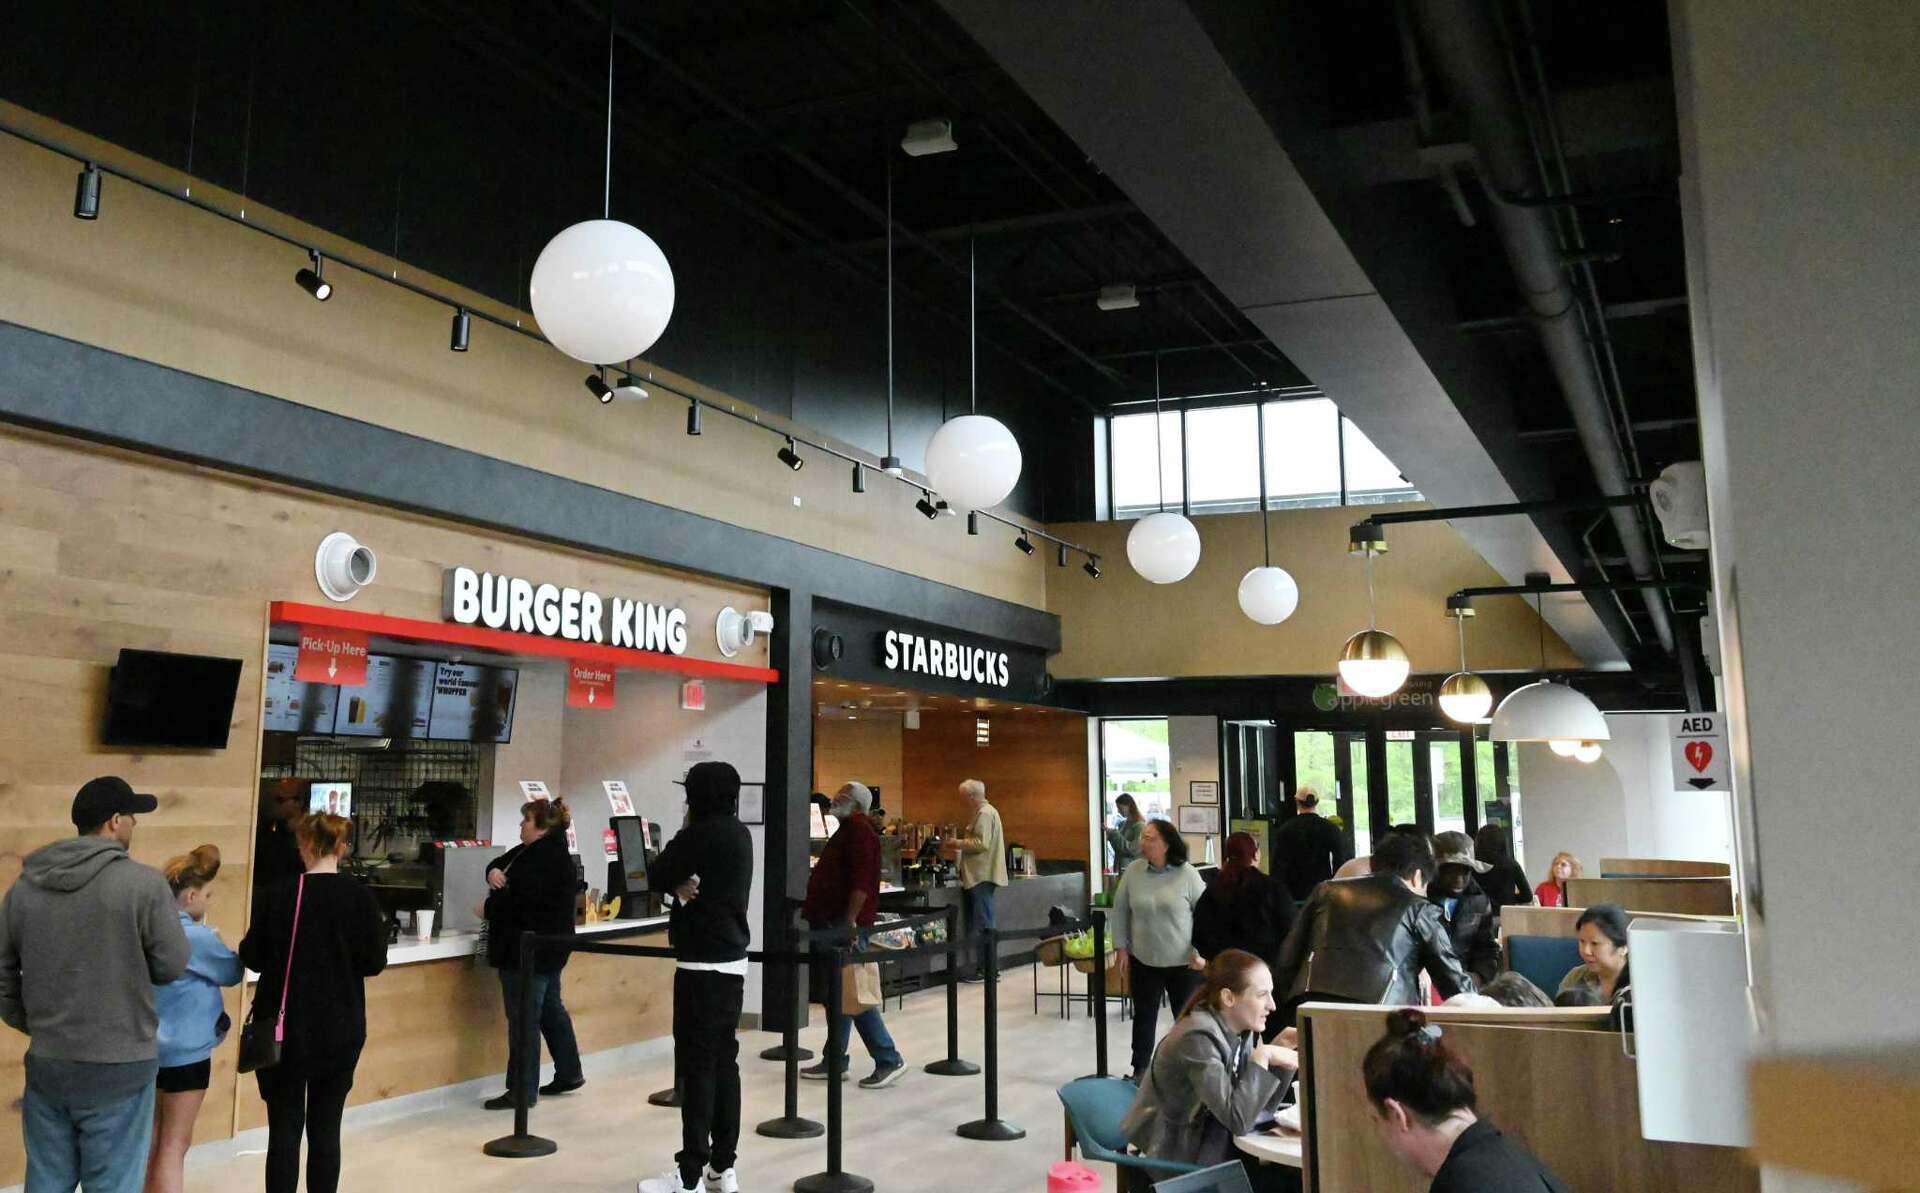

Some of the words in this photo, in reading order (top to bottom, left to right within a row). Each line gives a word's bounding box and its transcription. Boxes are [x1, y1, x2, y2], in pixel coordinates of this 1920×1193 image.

[453, 566, 603, 644] BURGER
[612, 596, 687, 655] KING
[302, 636, 341, 656] Pick-Up
[342, 642, 367, 657] Here
[885, 629, 1009, 687] STARBUCKS
[440, 667, 452, 677] Try
[574, 667, 594, 680] Order
[595, 670, 611, 682] Here
[1681, 717, 1713, 733] AED
